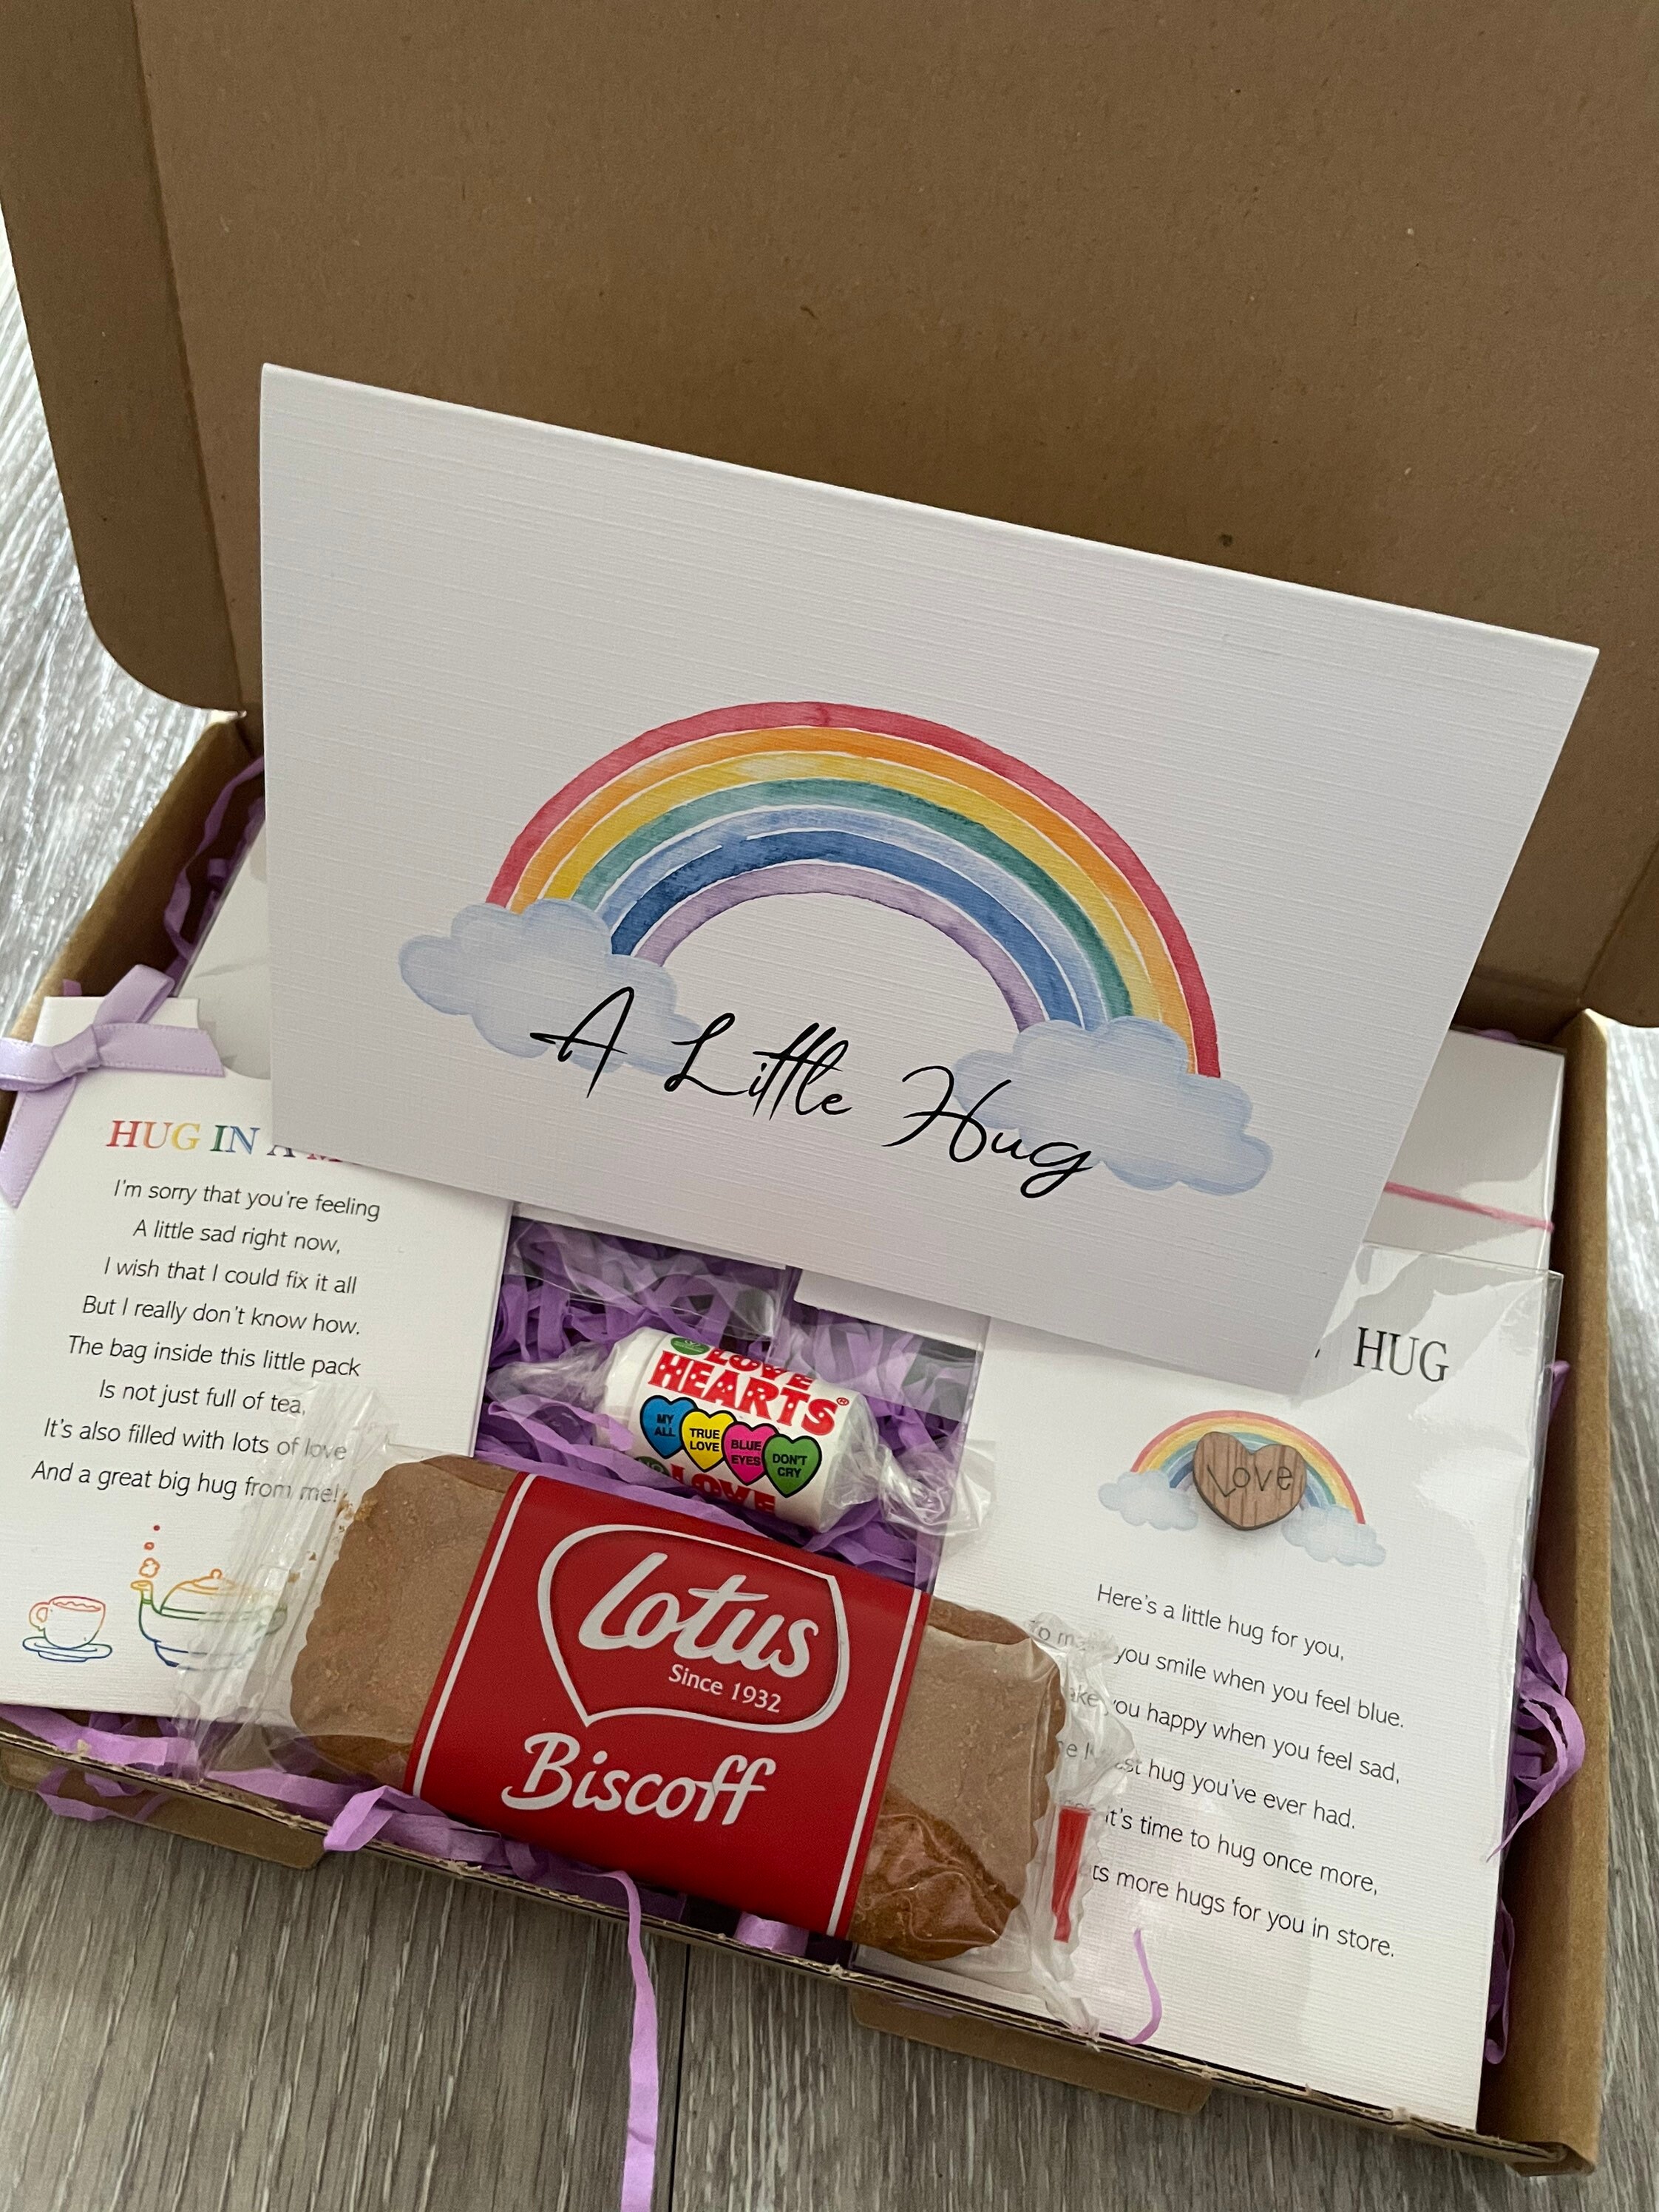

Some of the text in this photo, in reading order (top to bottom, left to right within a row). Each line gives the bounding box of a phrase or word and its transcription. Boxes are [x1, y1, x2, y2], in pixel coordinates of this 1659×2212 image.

[529, 986, 1093, 1198] A Little Hug
[106, 1120, 201, 1150] HUG
[210, 1124, 260, 1155] IN
[113, 1178, 381, 1223] I'm sorry that you're feeling
[132, 1218, 340, 1255] A little sad right now,
[104, 1256, 358, 1295] I wish that I could fix it all
[82, 1295, 360, 1335] But I really don't know how.
[68, 1334, 362, 1378] The bag inside this little pack
[1353, 1326, 1450, 1382] HUG
[98, 1379, 305, 1416] Is not just full of tea,
[648, 1351, 838, 1436] HEARTS
[44, 1417, 347, 1459] It's also filled with lots of love
[654, 1428, 676, 1437] ALL
[657, 1414, 674, 1425] MY
[689, 1428, 720, 1439] TRUE
[690, 1442, 720, 1452] LOVE
[730, 1439, 761, 1451] BLUE
[730, 1455, 761, 1467] EYES
[773, 1453, 808, 1465] DON'T
[30, 1459, 339, 1502] And a great big hug from me!
[777, 1467, 801, 1478] CRY
[1207, 1465, 1292, 1497] Love
[577, 1553, 819, 1677] Lotus
[1097, 1583, 1344, 1662] Here's a little hug for you,
[668, 1663, 782, 1714] Since 1932
[1113, 1647, 1150, 1666] you
[1155, 1656, 1207, 1680] smile
[1212, 1668, 1265, 1694] when
[1271, 1683, 1309, 1705] you
[1315, 1689, 1351, 1715] feel
[1357, 1698, 1404, 1728] blue.
[1147, 1702, 1208, 1740] happy
[1212, 1722, 1266, 1750] when
[1272, 1738, 1310, 1760] you
[1317, 1744, 1353, 1771] feel
[1359, 1760, 1400, 1785] sad,
[501, 1733, 776, 1826] Biscoff
[1148, 1758, 1186, 1791] hug
[1190, 1774, 1257, 1804] you've
[1263, 1793, 1308, 1816] ever
[1313, 1799, 1355, 1830] had.
[1140, 1815, 1184, 1843] time
[1190, 1828, 1210, 1850] to
[1217, 1833, 1255, 1867] hug
[1263, 1851, 1313, 1876] once
[1320, 1865, 1377, 1896] more,
[1116, 1871, 1169, 1899] more
[1175, 1881, 1226, 1916] hugs
[1232, 1896, 1262, 1922] for
[1266, 1910, 1305, 1934] you
[1312, 1916, 1329, 1941] in
[1336, 1928, 1394, 1958] store.
